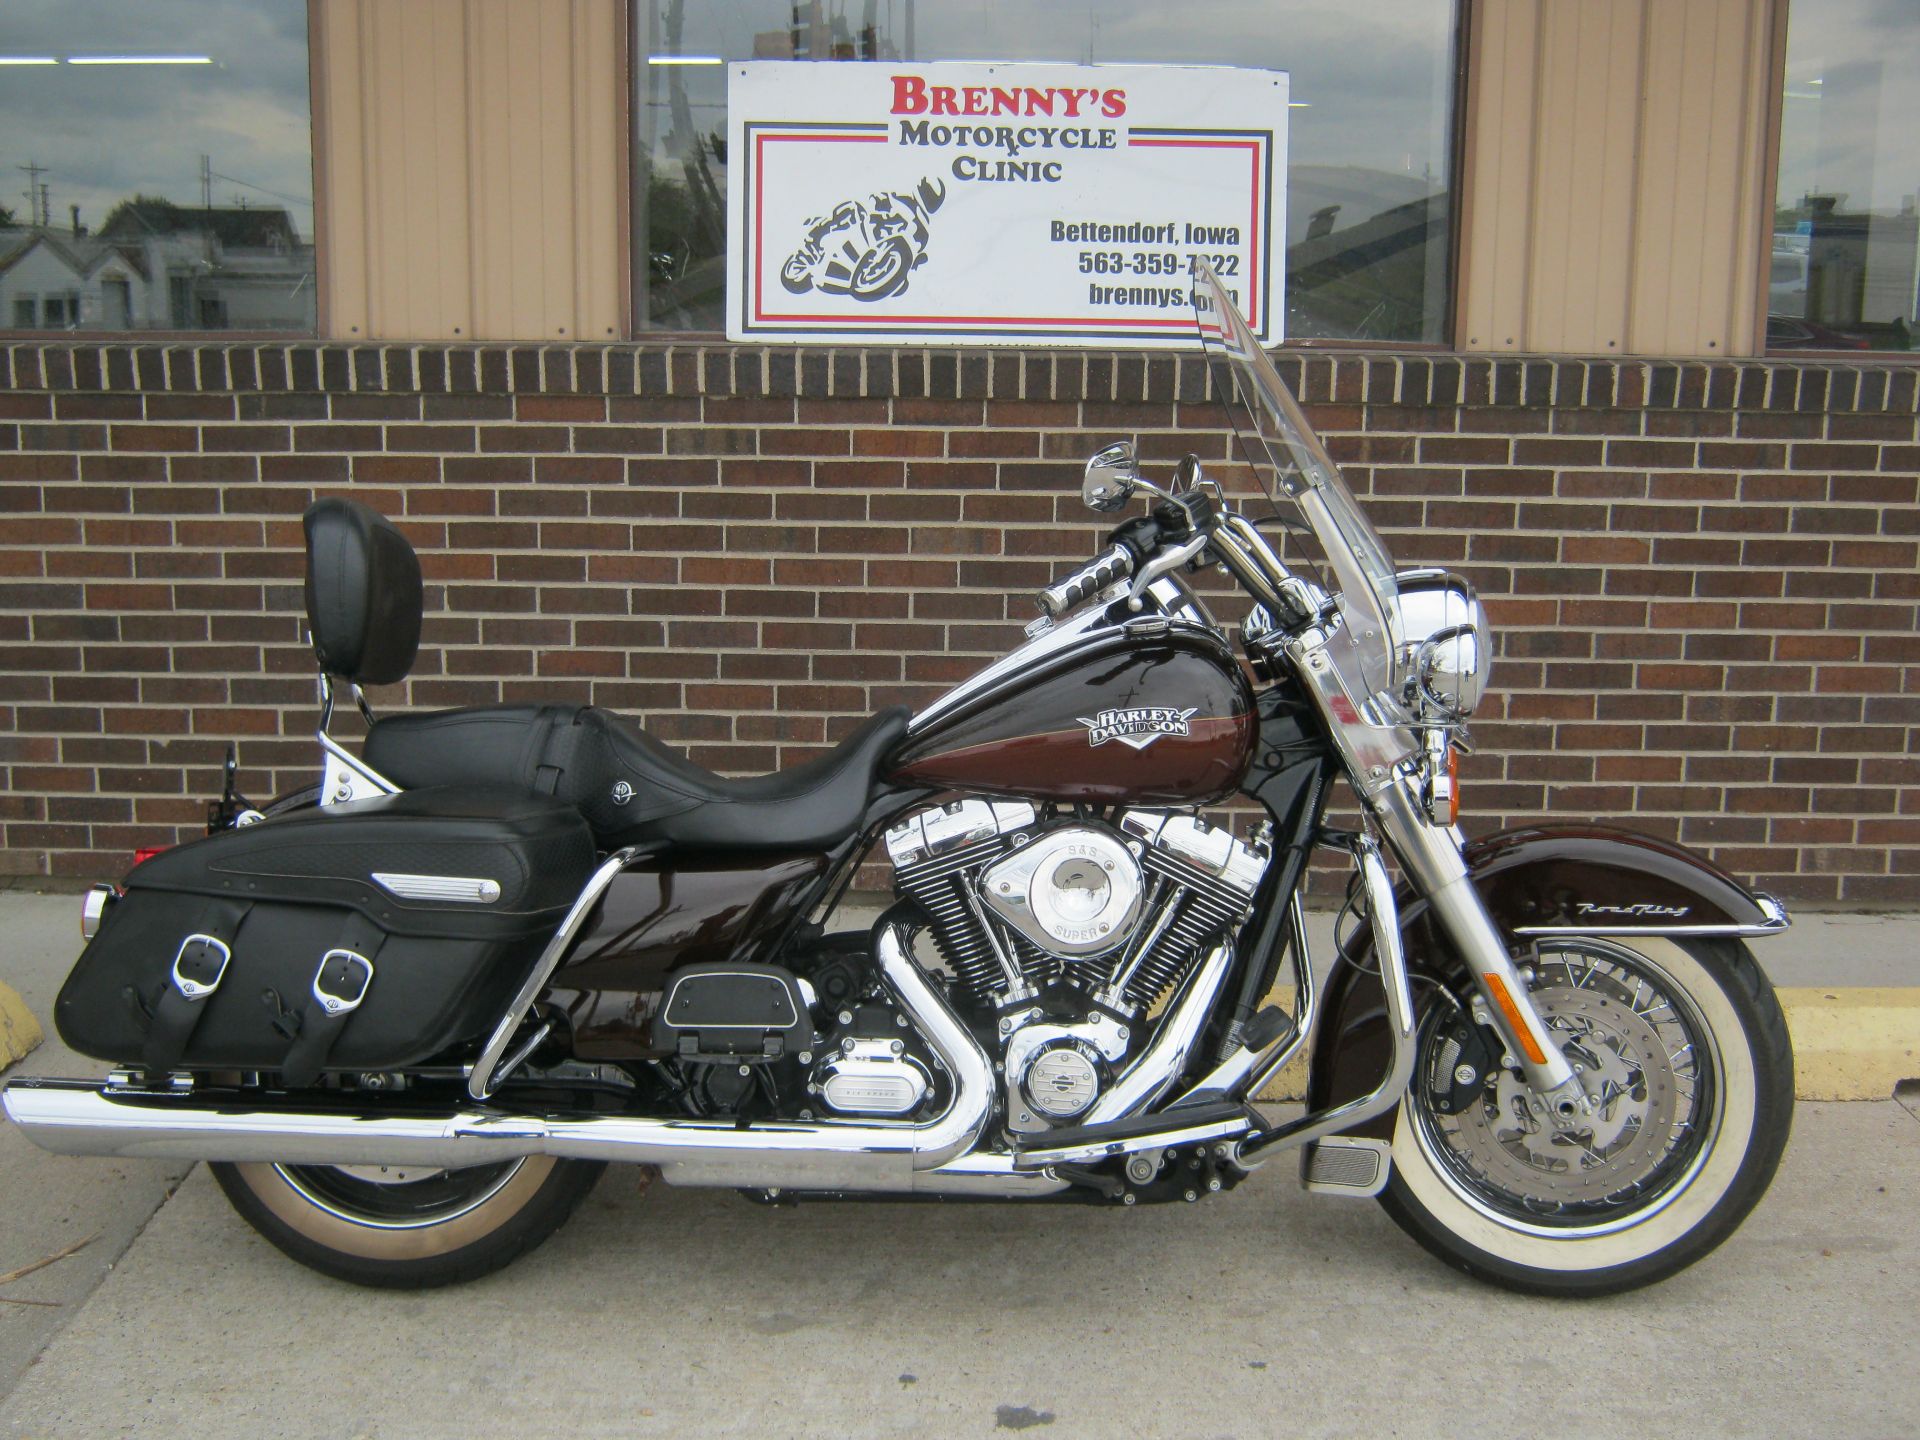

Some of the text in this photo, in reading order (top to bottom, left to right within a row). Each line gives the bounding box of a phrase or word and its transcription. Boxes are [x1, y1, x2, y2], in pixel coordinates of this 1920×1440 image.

[890, 76, 1126, 118] BRENNY'S
[899, 120, 1117, 155] MOTORCYCLE
[952, 156, 1062, 182] CLINIC
[1050, 220, 1240, 246] Bettendorf, Iowa
[1091, 721, 1186, 744] DAVIDSON
[1054, 925, 1098, 940] SUPER
